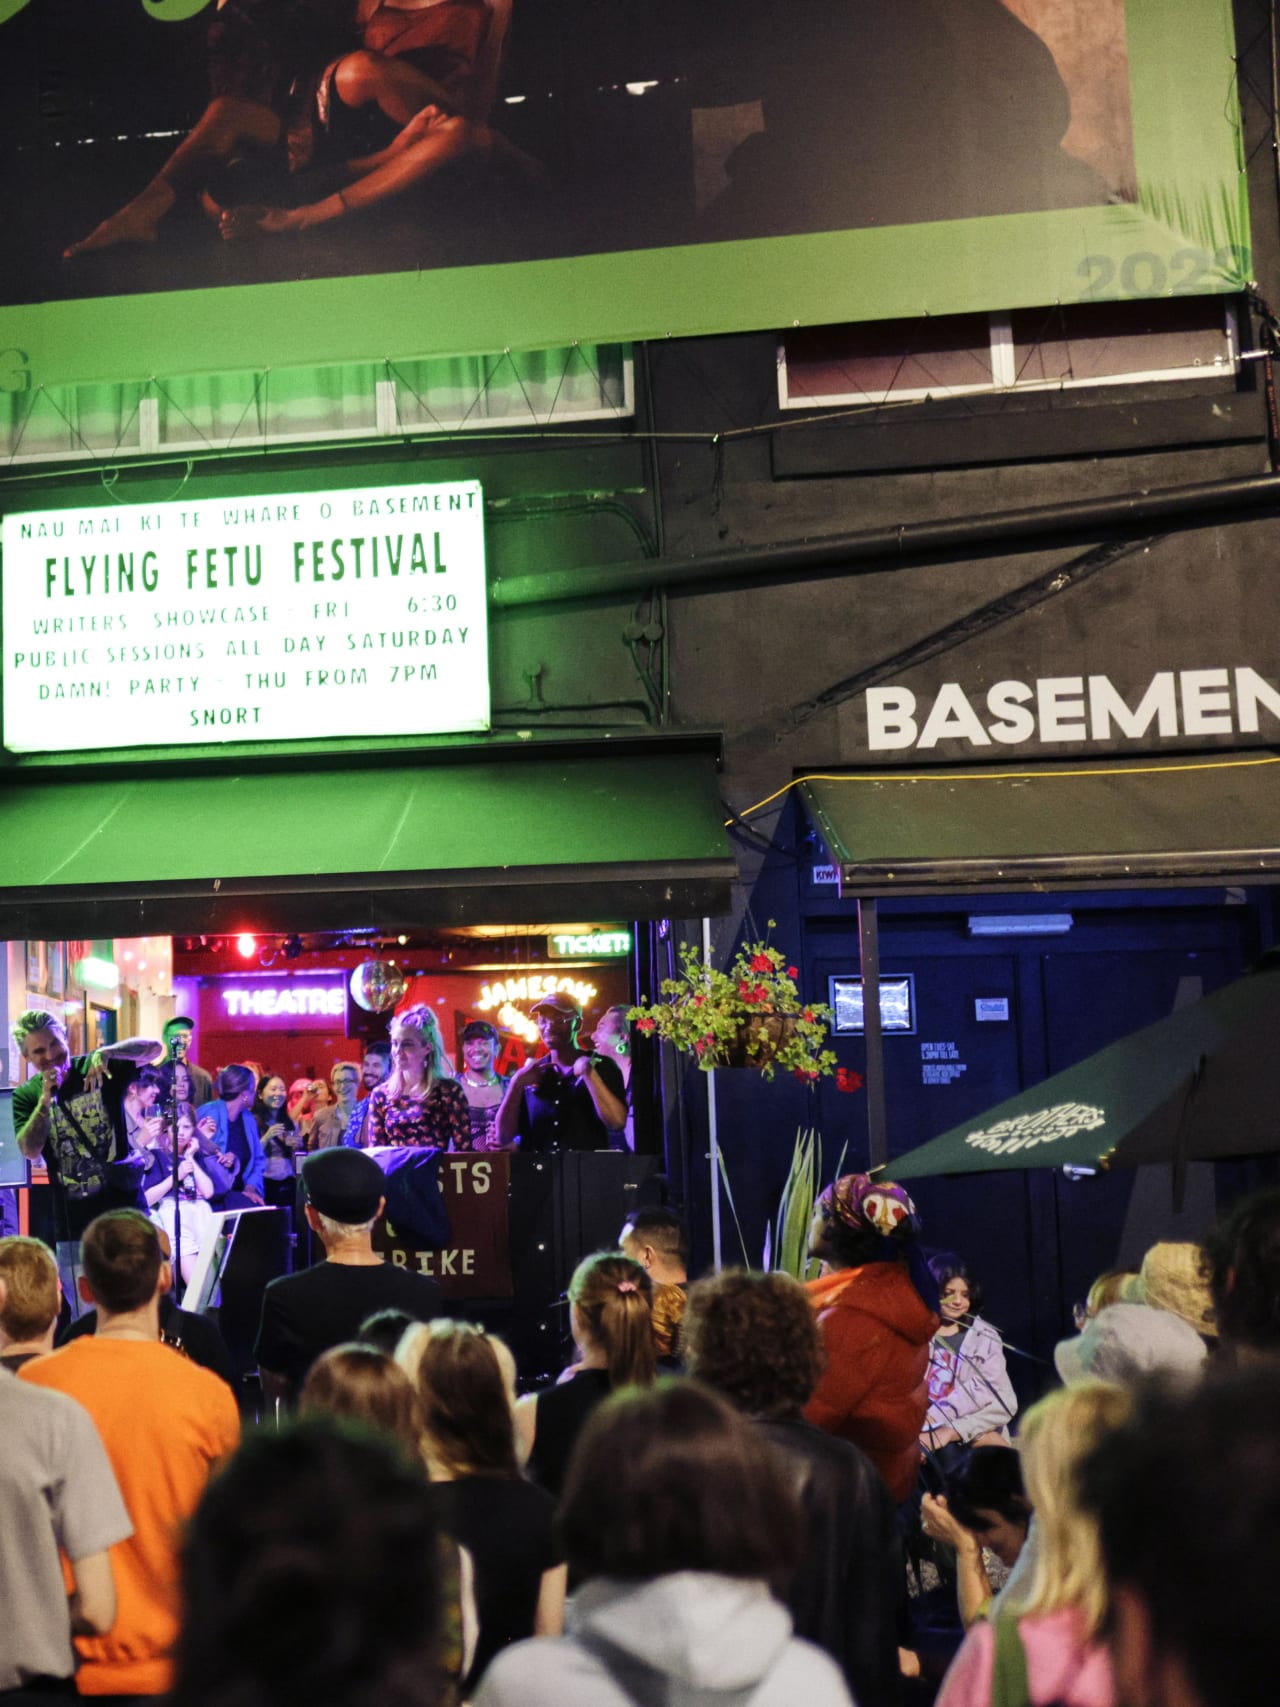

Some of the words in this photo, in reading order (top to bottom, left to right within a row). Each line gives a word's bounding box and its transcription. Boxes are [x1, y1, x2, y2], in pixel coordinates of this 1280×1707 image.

[21, 521, 64, 539] NAU
[78, 517, 119, 536] MAI
[141, 514, 161, 530] KI
[180, 511, 201, 528] TE
[223, 505, 300, 525] WHARE
[320, 502, 332, 519] O
[352, 492, 476, 516] BASEMENT
[46, 551, 159, 598] FLYING
[187, 544, 261, 590] FETU
[293, 532, 447, 583] FESTIVAL
[33, 614, 127, 635] WRITERS
[154, 606, 270, 628] SHOWCASE
[314, 601, 349, 619] FRI
[407, 594, 457, 613] 6:30
[14, 648, 90, 669] PUBLIC
[107, 642, 205, 663] SESSIONS
[226, 639, 261, 656] ALL
[283, 635, 326, 654] DAY
[347, 627, 469, 650] SATURDAY
[39, 680, 110, 700] DAMN!
[129, 675, 200, 695] PARTY
[245, 671, 286, 689] THU
[305, 667, 368, 687] FROM
[389, 663, 438, 683] 7PM
[190, 707, 262, 726] SNORT
[222, 988, 345, 1016] THEATRE
[374, 1249, 475, 1276] RIKE
